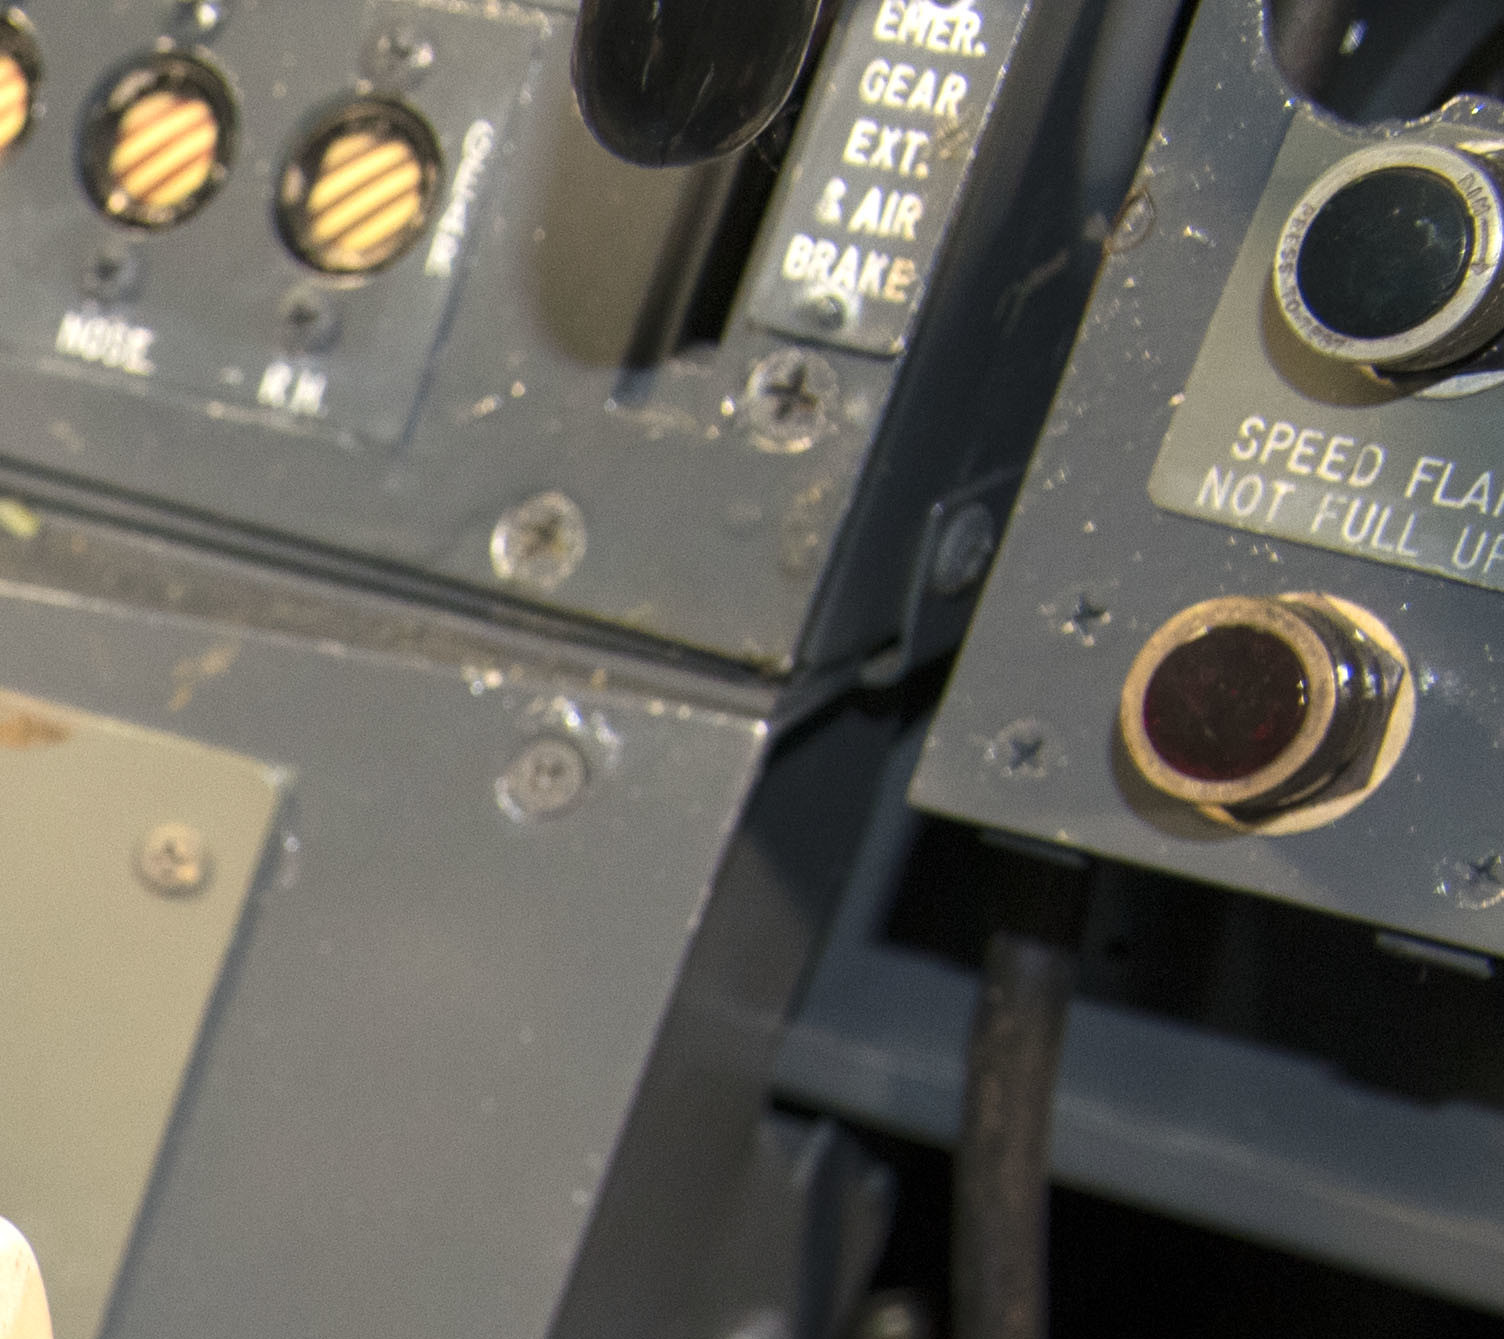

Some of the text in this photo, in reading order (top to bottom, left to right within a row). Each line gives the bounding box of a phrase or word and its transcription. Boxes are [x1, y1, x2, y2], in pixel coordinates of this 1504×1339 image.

[859, 58, 968, 118] GEAR
[842, 117, 929, 180] EXT.
[815, 177, 923, 241] & AIR
[782, 233, 916, 303] BRAKE
[1231, 416, 1386, 488] SPEED
[1195, 463, 1296, 524] NOT
[1309, 492, 1418, 558] FULL
